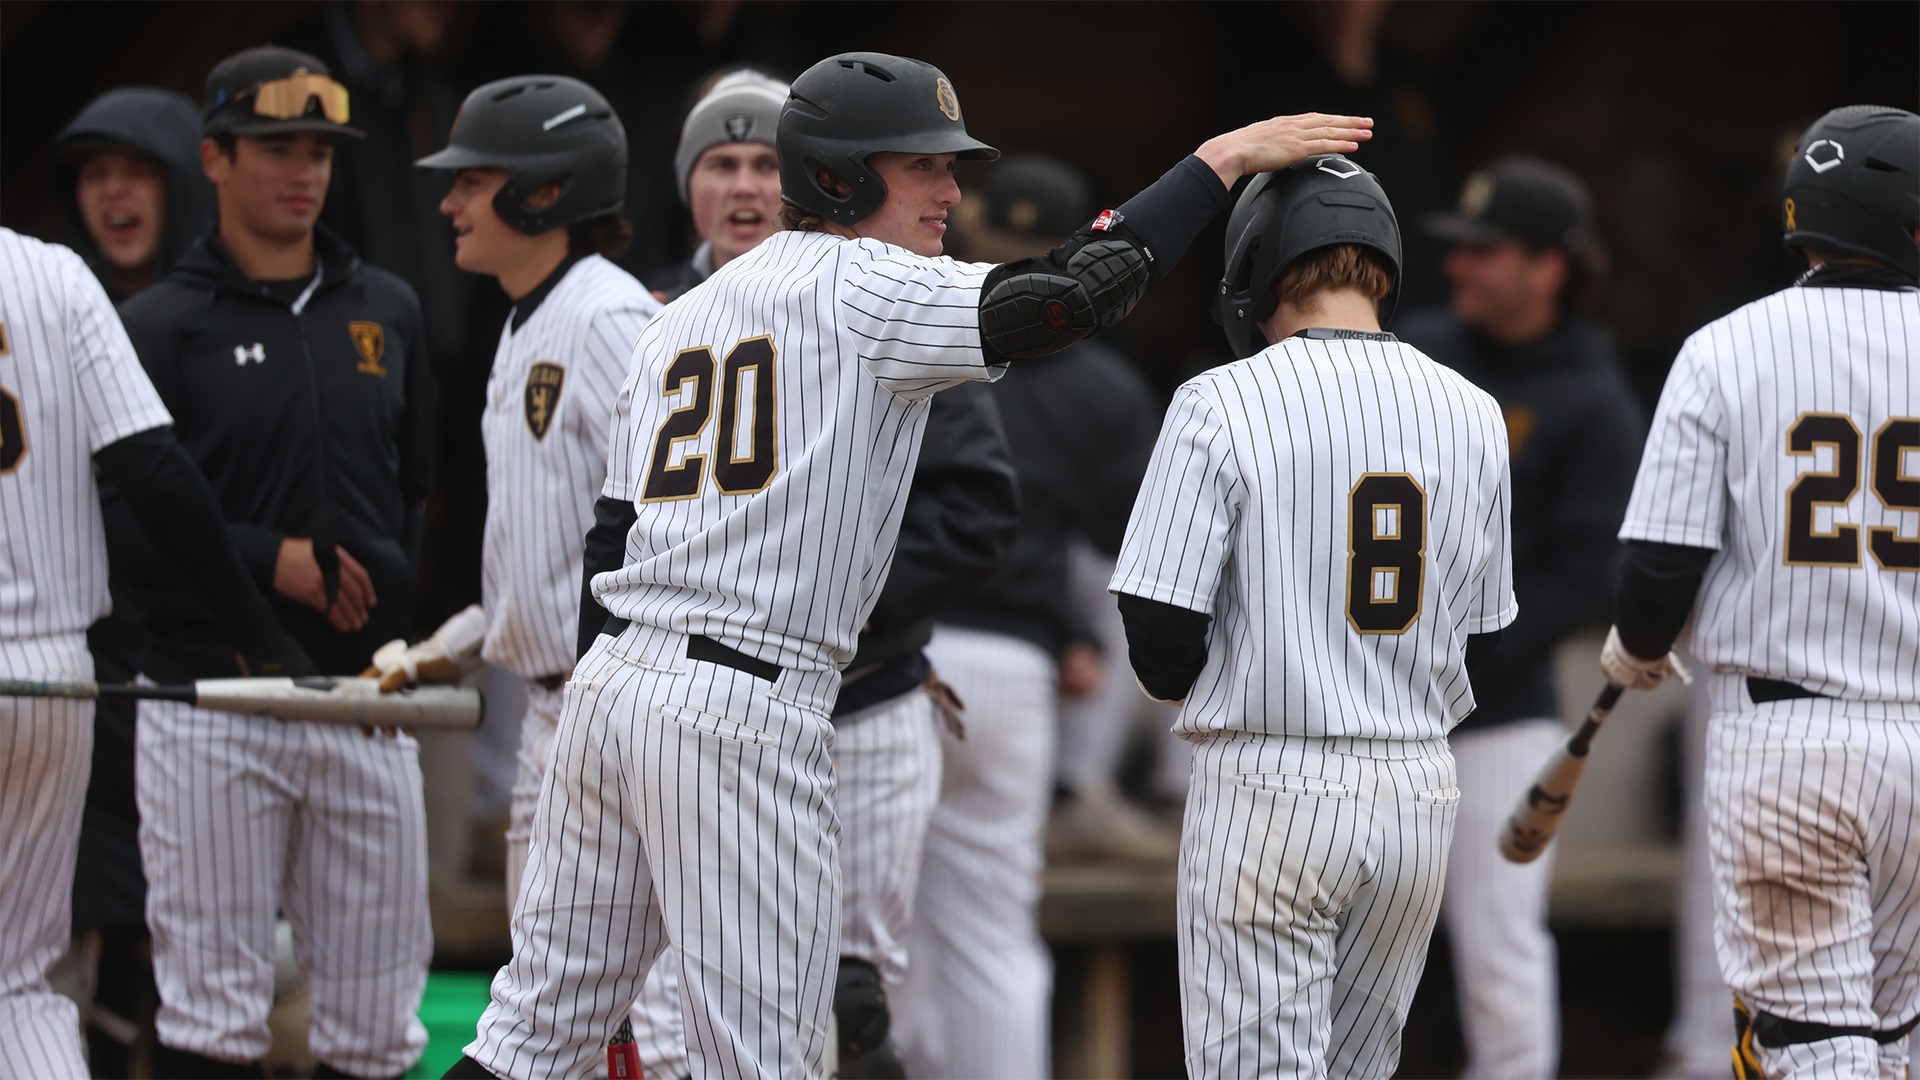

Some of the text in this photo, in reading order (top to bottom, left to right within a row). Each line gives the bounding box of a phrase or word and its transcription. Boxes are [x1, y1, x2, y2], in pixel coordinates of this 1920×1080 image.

[1333, 329, 1391, 342] NIKE PRO
[640, 334, 779, 504] 20
[1783, 411, 1920, 572] 29
[1344, 471, 1428, 635] 8
